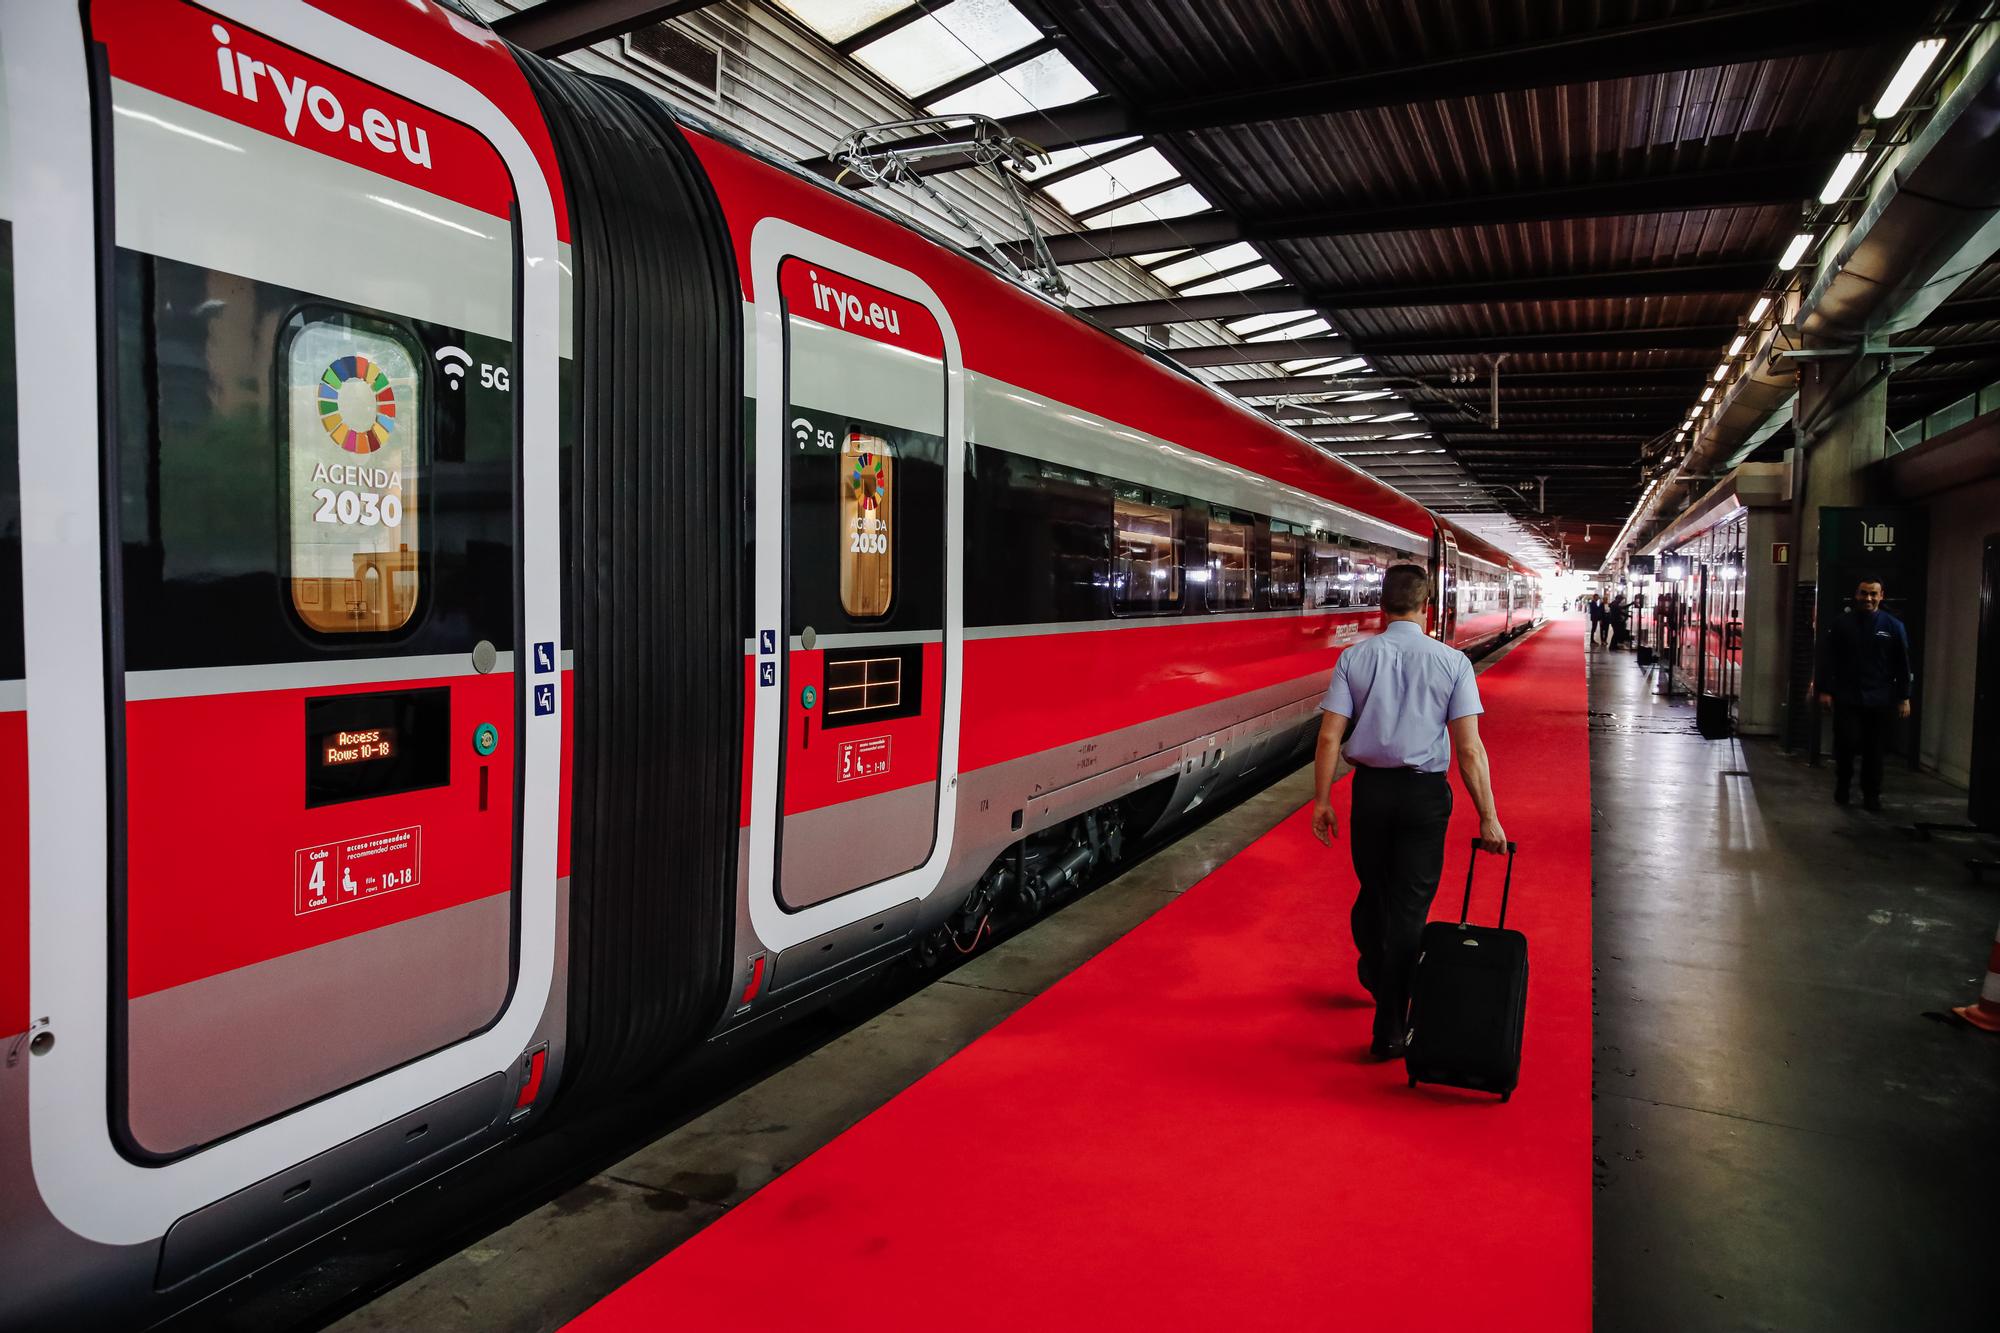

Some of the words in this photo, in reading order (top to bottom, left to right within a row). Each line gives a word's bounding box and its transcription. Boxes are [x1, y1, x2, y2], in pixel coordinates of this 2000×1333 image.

[211, 23, 432, 170] iryo.eu
[809, 270, 900, 336] iryo.eu
[480, 363, 510, 392] 5G
[817, 429, 834, 449] 5G
[312, 462, 402, 490] AGENDA
[313, 488, 403, 528] 2030
[849, 517, 887, 532] AGENDA
[850, 532, 887, 554] 2030
[339, 731, 380, 746] Access
[328, 748, 359, 763] Rows
[360, 741, 390, 758] 10-18
[843, 750, 851, 773] 5
[346, 842, 368, 853] acceso
[369, 832, 411, 848] recomendado
[347, 845, 389, 861] recommended
[389, 842, 408, 851] access
[308, 860, 326, 897] 4
[381, 867, 412, 889] 10-18
[308, 896, 328, 908] Coach
